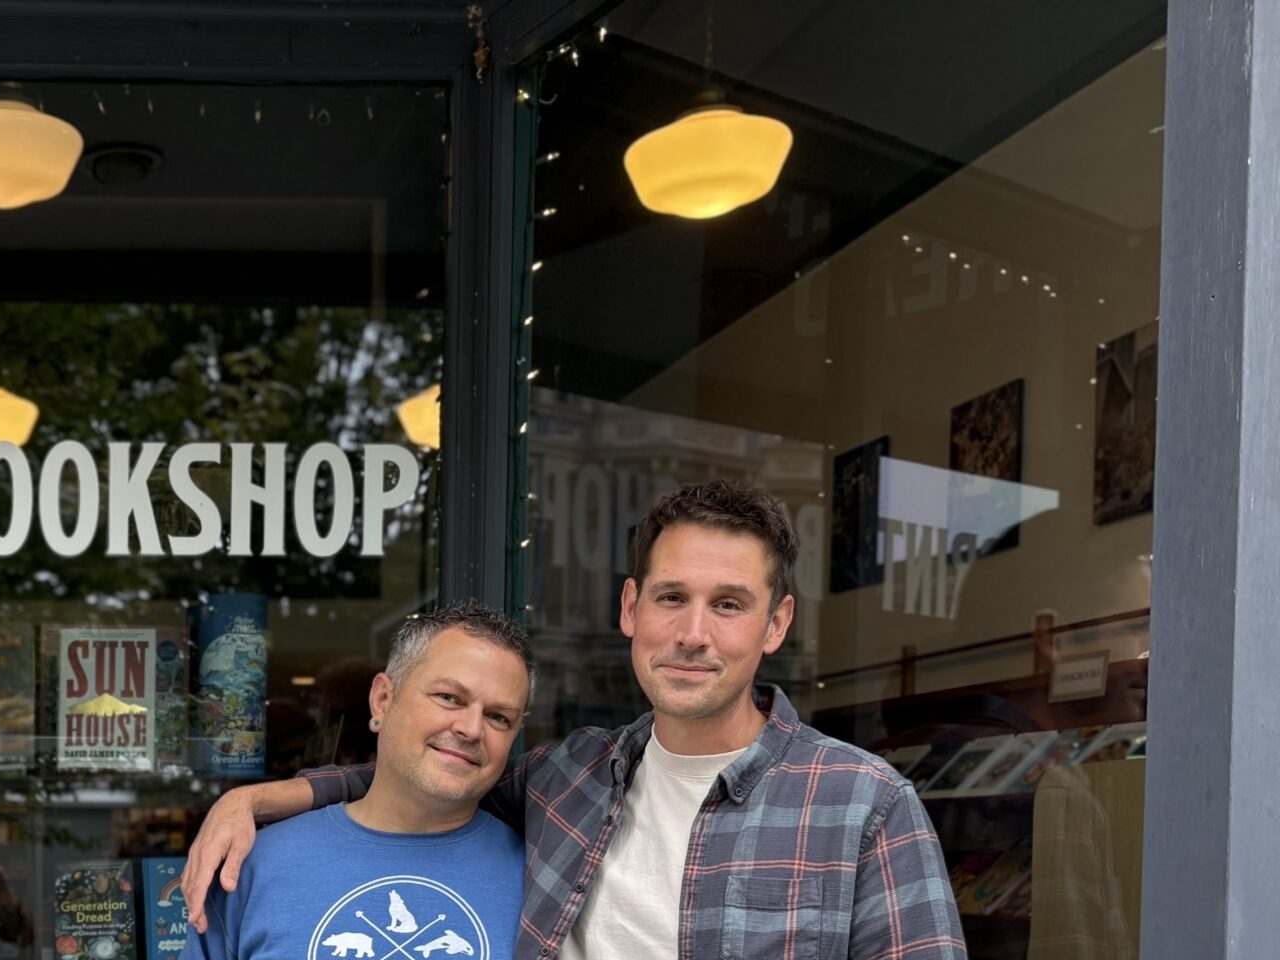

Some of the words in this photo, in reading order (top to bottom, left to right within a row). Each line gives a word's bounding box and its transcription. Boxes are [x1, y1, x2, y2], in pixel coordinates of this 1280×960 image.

[66, 640, 149, 698] SUN
[65, 713, 147, 747] HOUSE
[64, 750, 87, 758] DAVID
[88, 750, 114, 758] JAMES
[211, 755, 240, 764] Ocean
[60, 900, 127, 912] Generation
[76, 912, 112, 923] Dread
